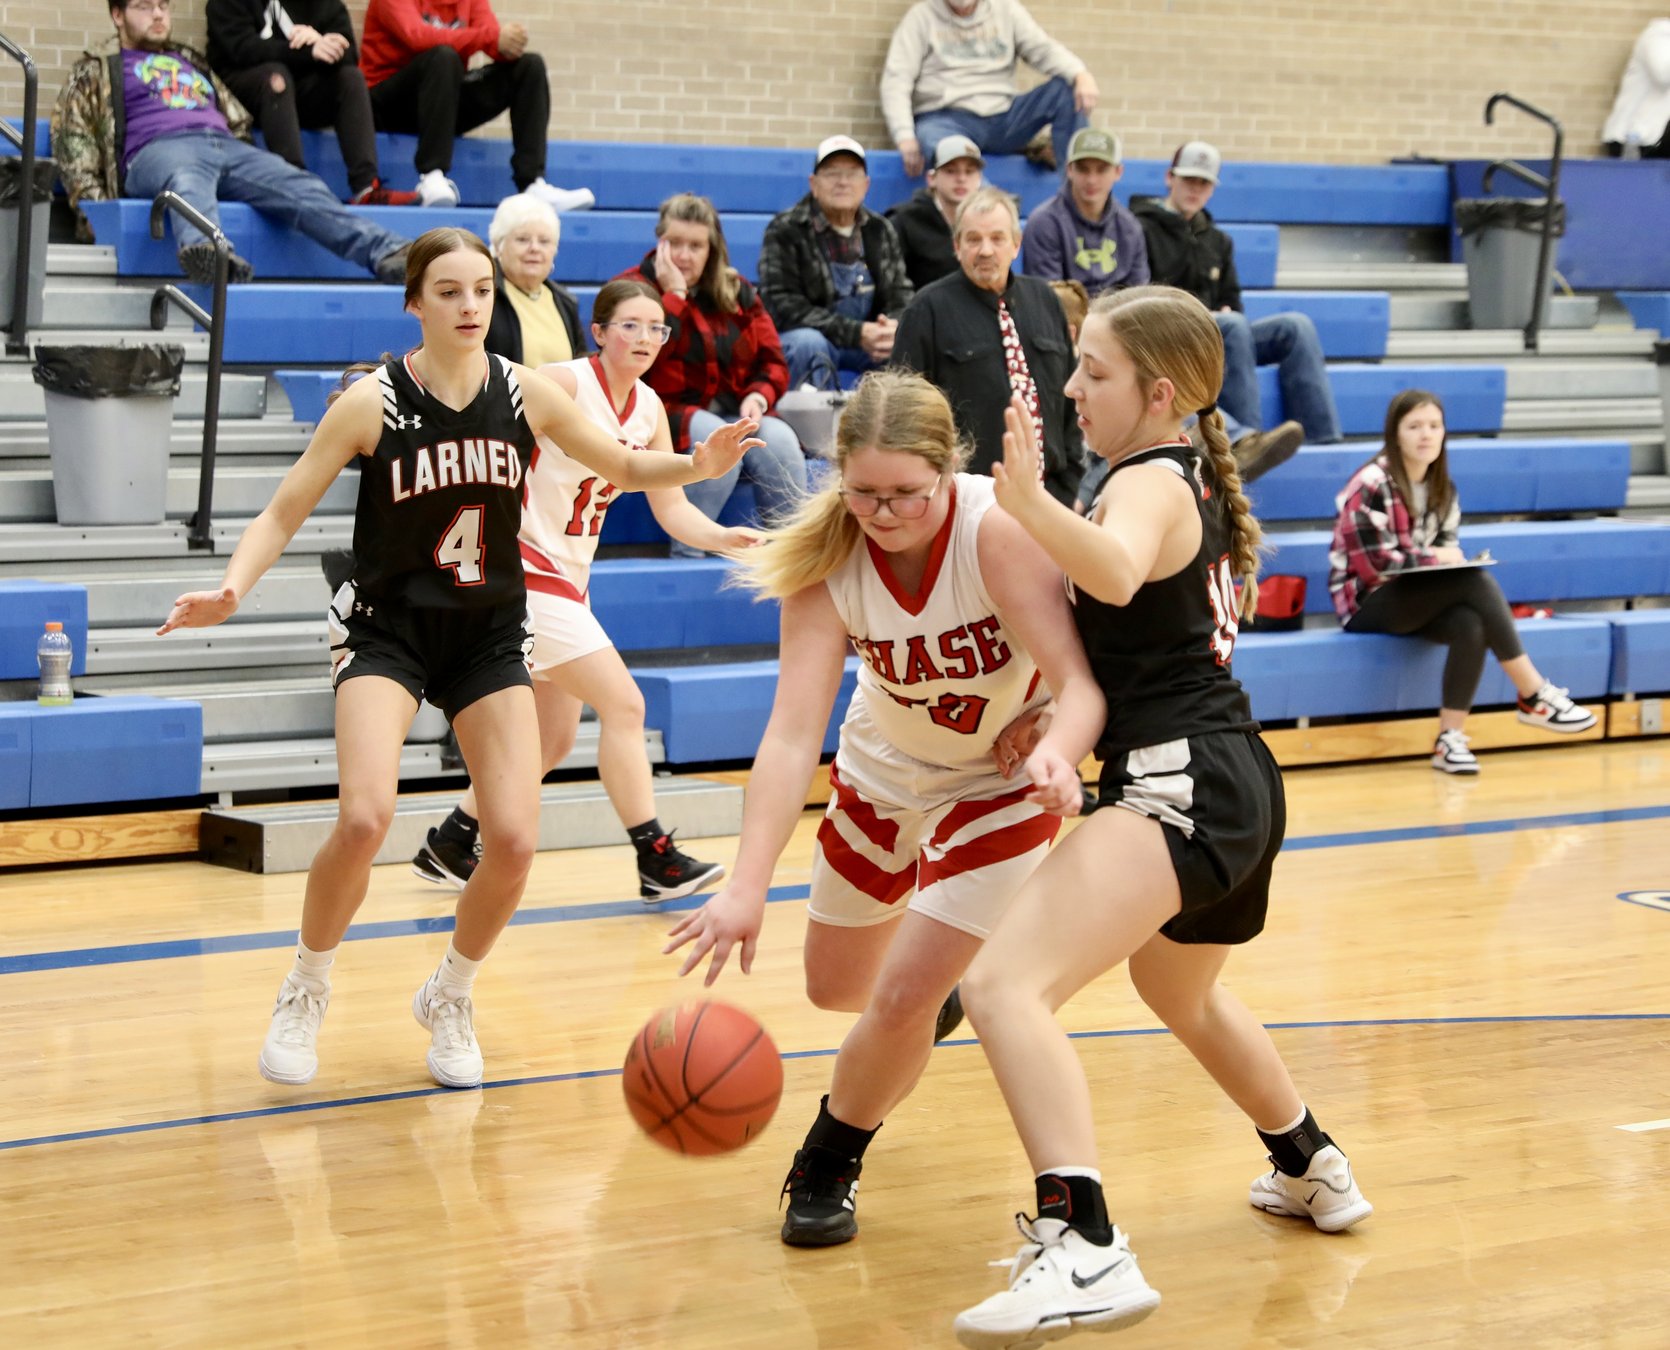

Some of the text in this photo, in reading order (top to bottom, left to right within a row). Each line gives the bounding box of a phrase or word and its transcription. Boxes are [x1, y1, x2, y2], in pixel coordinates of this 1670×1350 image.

[391, 437, 522, 503] LARNED
[434, 504, 486, 587] 4
[847, 614, 1012, 686] HASE
[880, 692, 990, 735] 0
